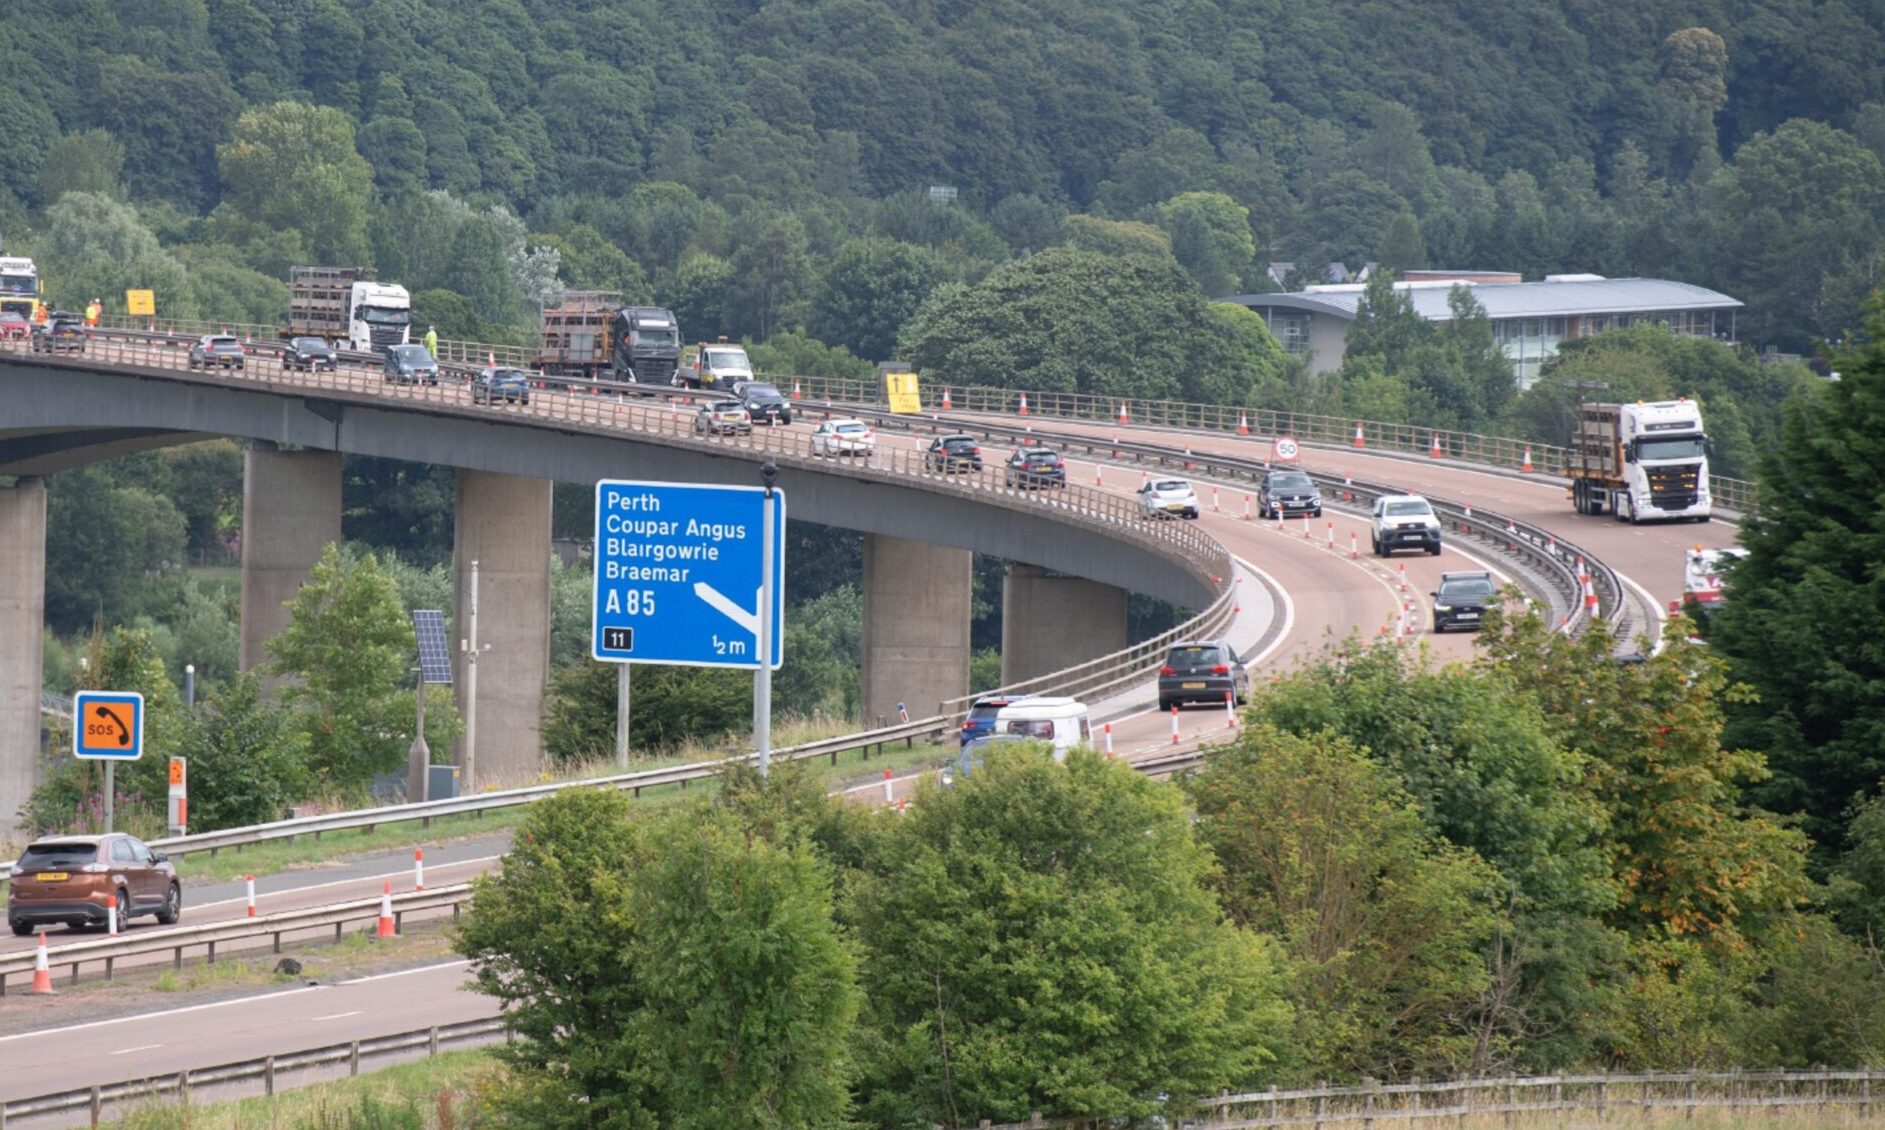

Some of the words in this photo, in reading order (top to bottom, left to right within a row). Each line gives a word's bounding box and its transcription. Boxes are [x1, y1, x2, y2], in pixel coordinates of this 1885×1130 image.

[1279, 443, 1296, 454] 50
[607, 492, 660, 511] Perth
[606, 515, 679, 537] Coupar
[685, 519, 746, 541] Angus
[606, 538, 719, 561] Blairgowrie
[606, 561, 690, 582] Braemar
[610, 631, 625, 648] 11
[88, 724, 114, 736] SOS
